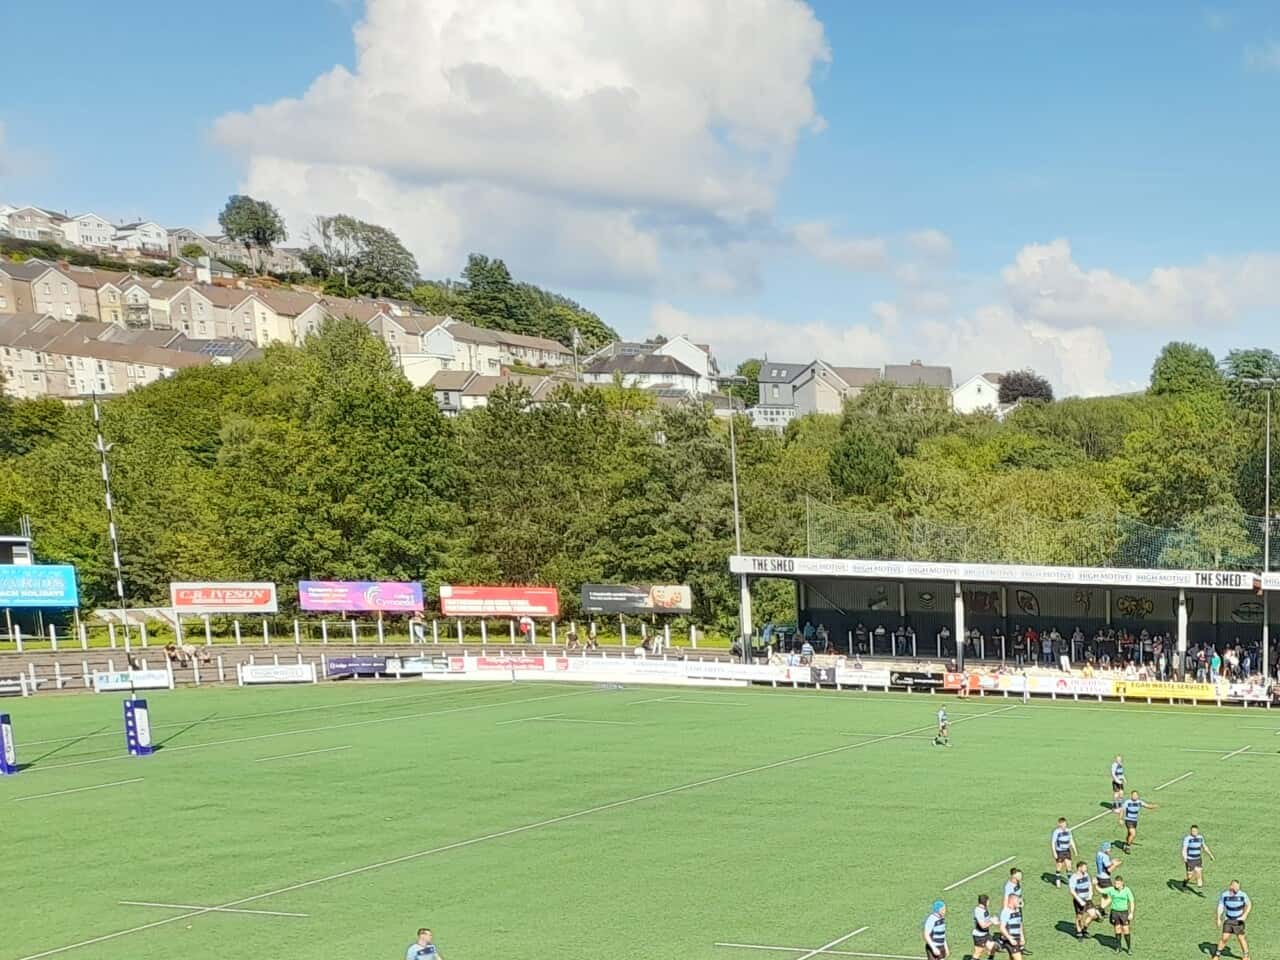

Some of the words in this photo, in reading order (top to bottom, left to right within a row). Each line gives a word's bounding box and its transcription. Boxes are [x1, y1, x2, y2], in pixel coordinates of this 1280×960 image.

[752, 559, 770, 571] THE
[771, 559, 795, 572] SHED
[1194, 573, 1213, 586] THE
[1215, 573, 1242, 587] SHED
